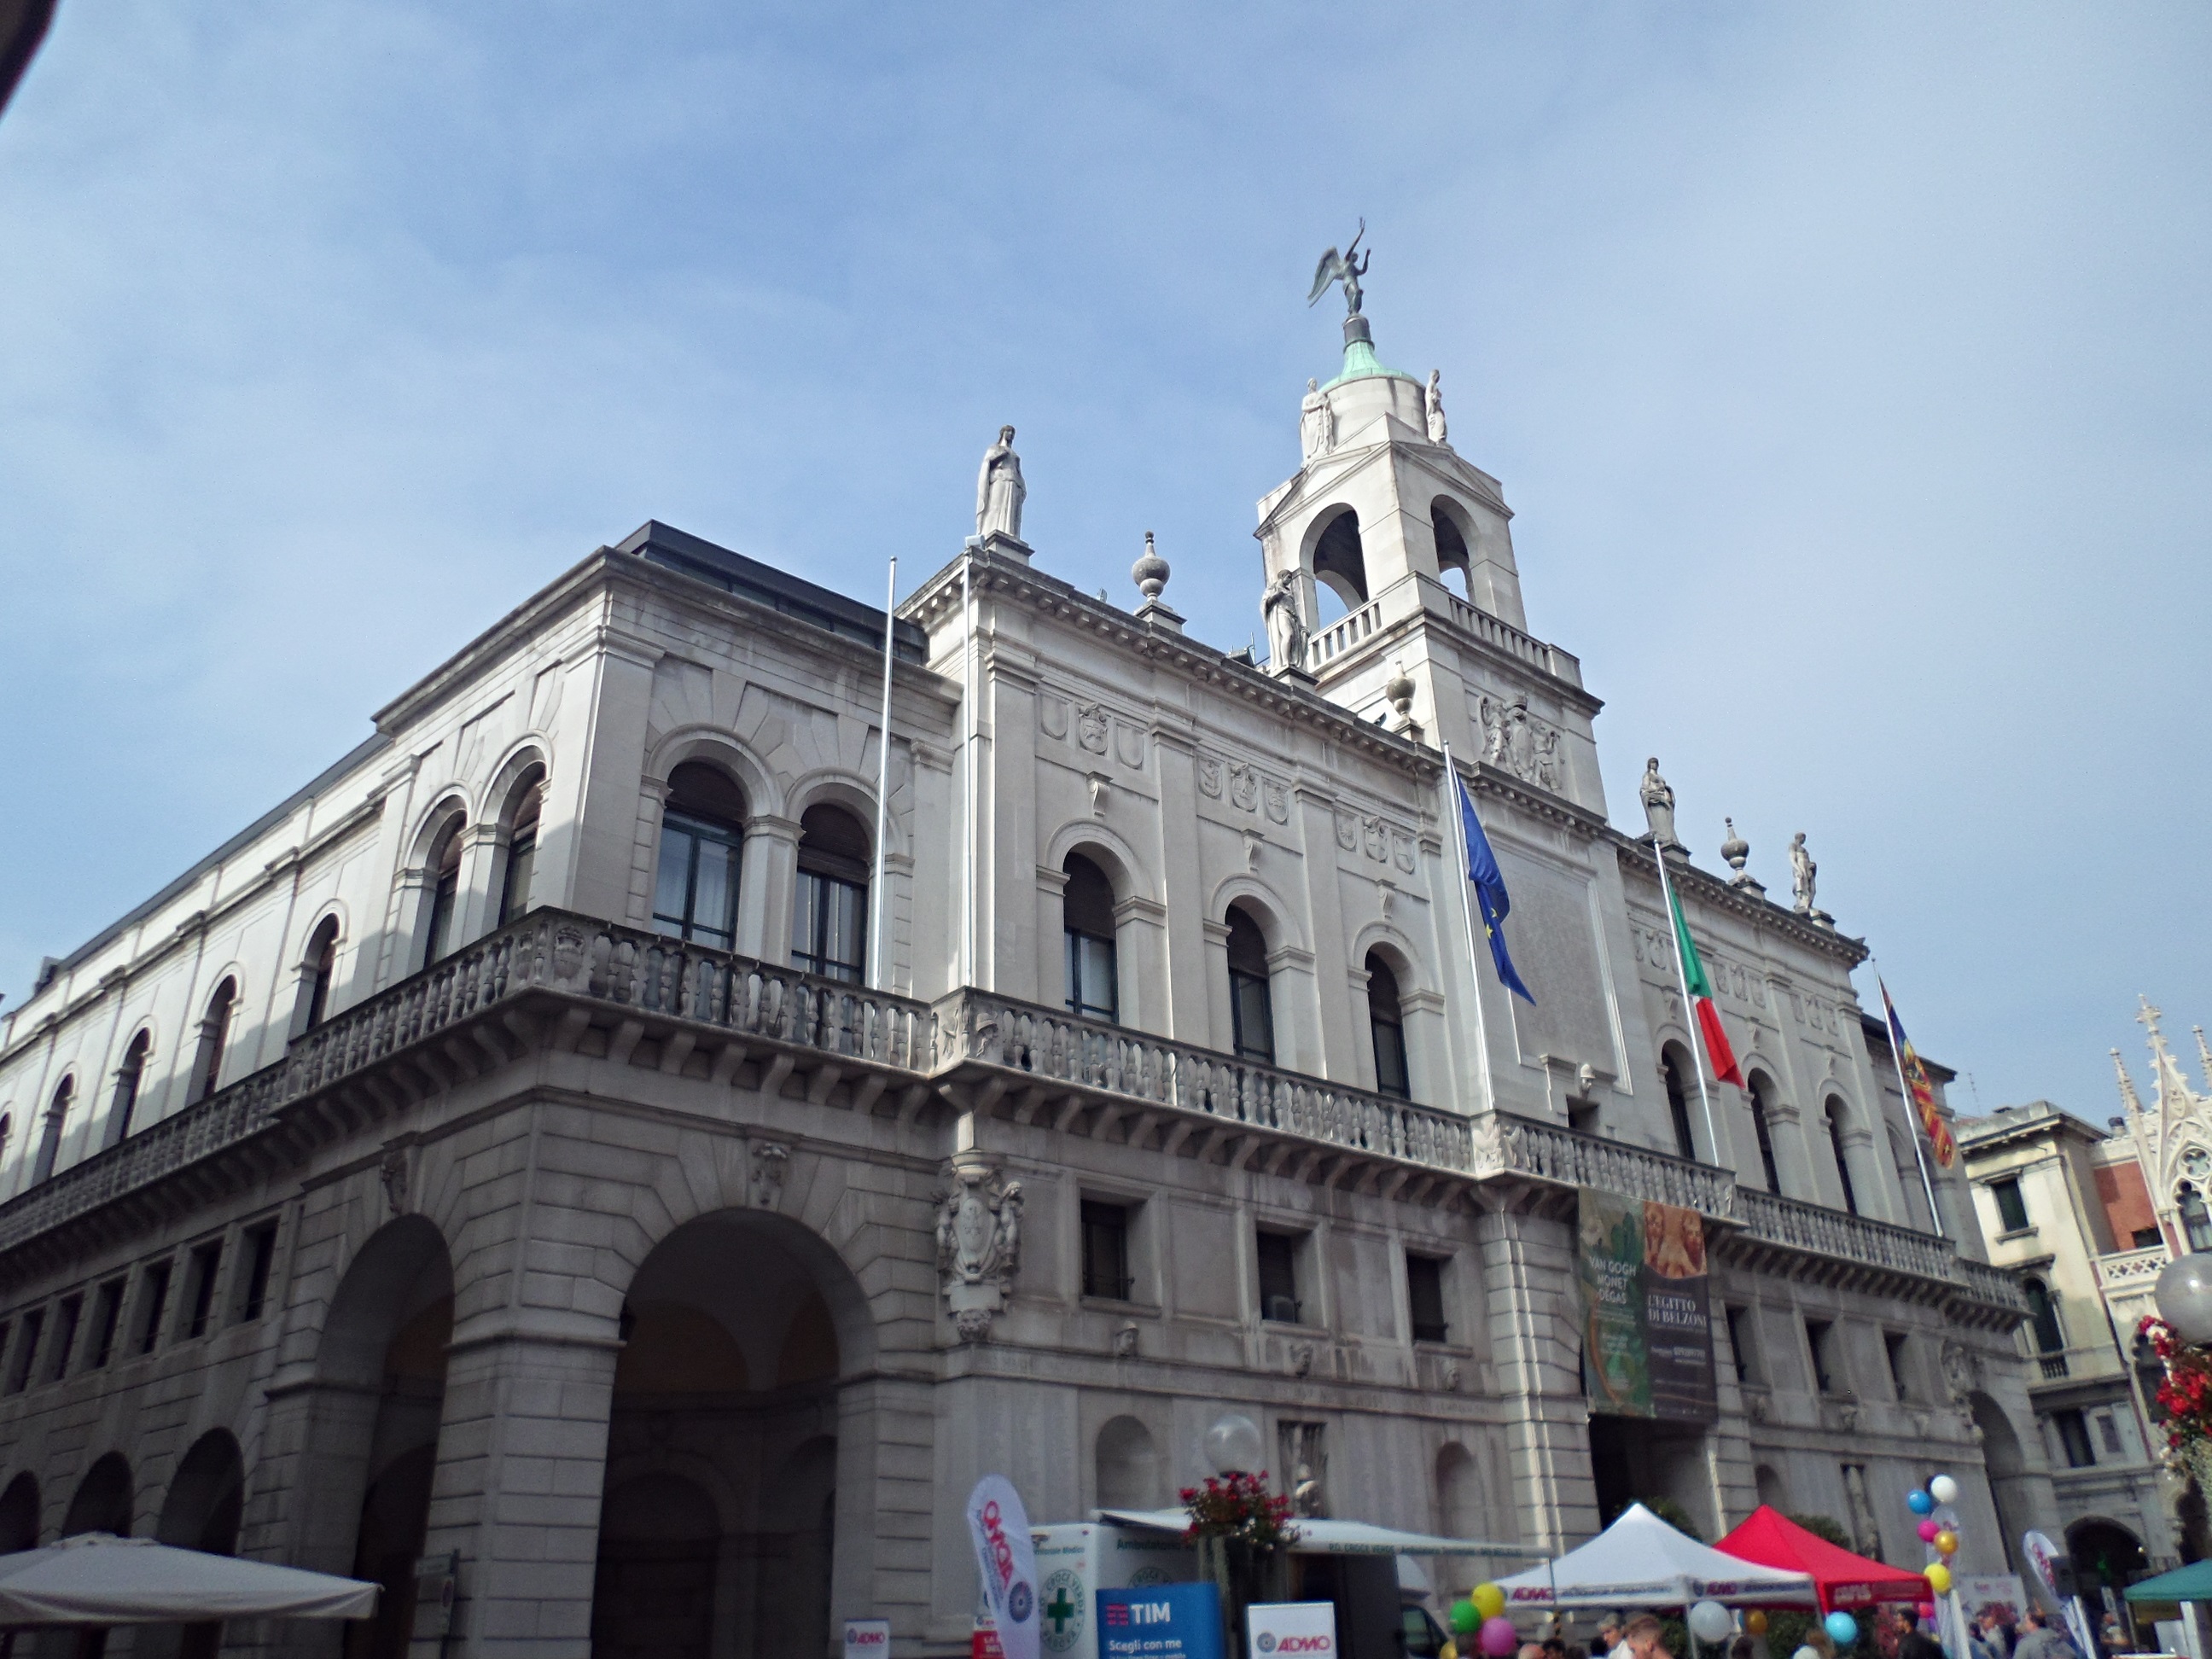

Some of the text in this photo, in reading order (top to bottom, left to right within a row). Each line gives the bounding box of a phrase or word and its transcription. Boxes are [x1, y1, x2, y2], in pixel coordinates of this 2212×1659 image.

[1589, 1256, 1637, 1277] VAN GOGH
[1597, 1274, 1628, 1290] MONET
[1598, 1289, 1627, 1304] DEGAS
[1648, 1308, 1660, 1322] DI
[1662, 1310, 1706, 1327] BELZONI
[1131, 1602, 1171, 1624] TIM
[856, 1631, 886, 1645] ADMO
[1109, 1639, 1183, 1654] Scegli con me
[1278, 1635, 1331, 1653] ADMO
